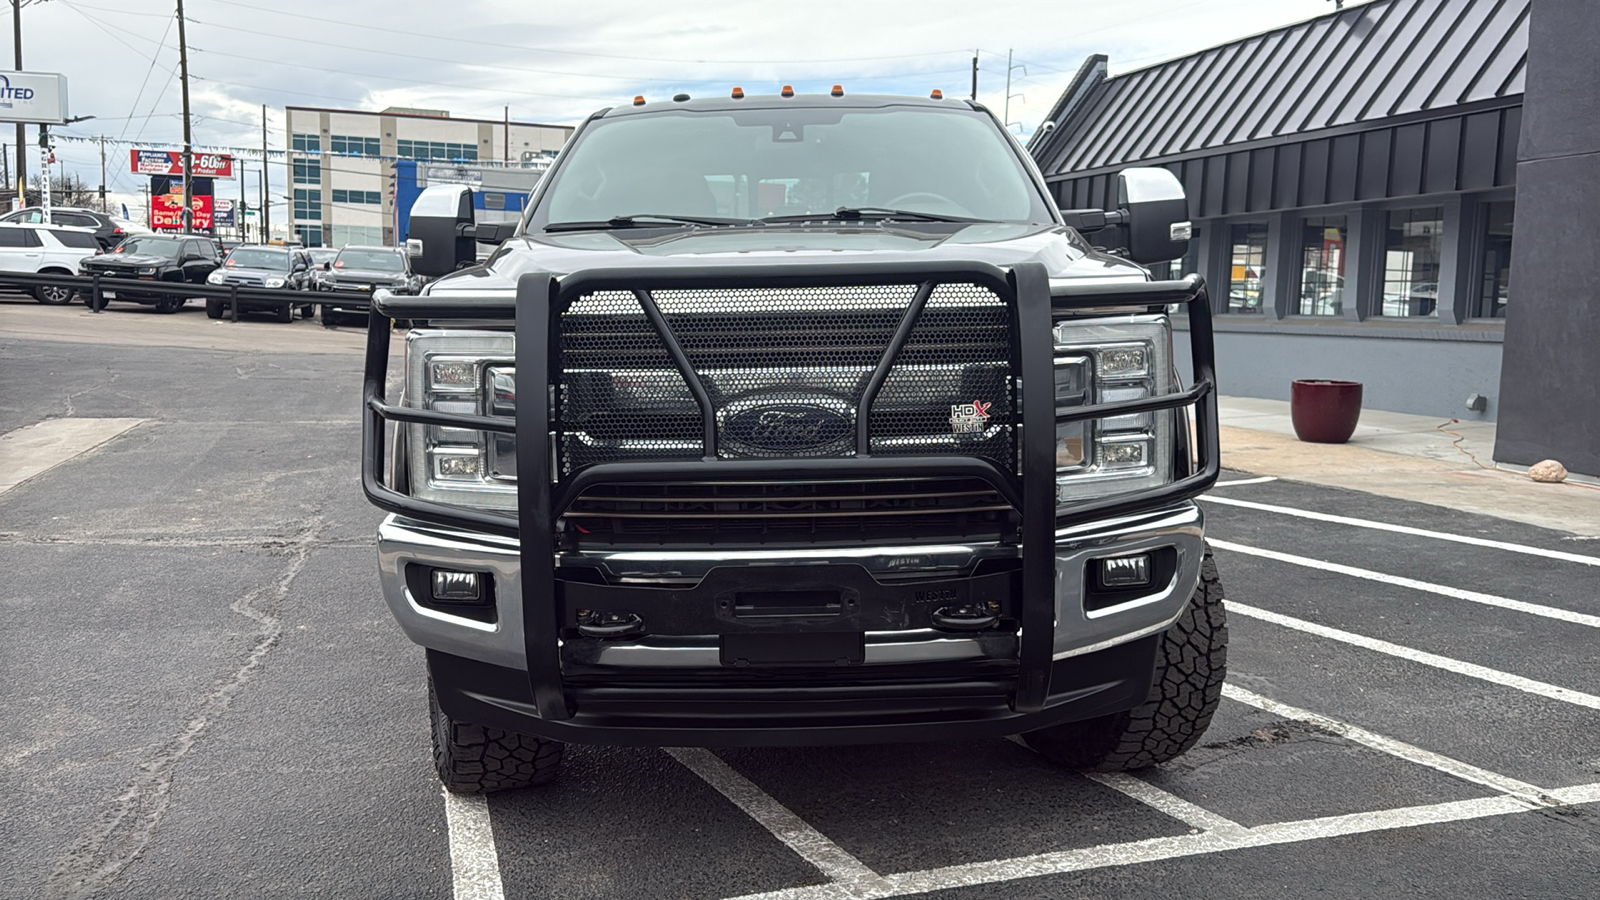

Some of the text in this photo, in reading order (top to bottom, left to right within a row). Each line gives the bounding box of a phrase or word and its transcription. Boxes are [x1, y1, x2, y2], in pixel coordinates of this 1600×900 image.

[0, 87, 34, 100] ITED
[951, 400, 992, 418] HDX
[915, 589, 958, 603] WESTIN
